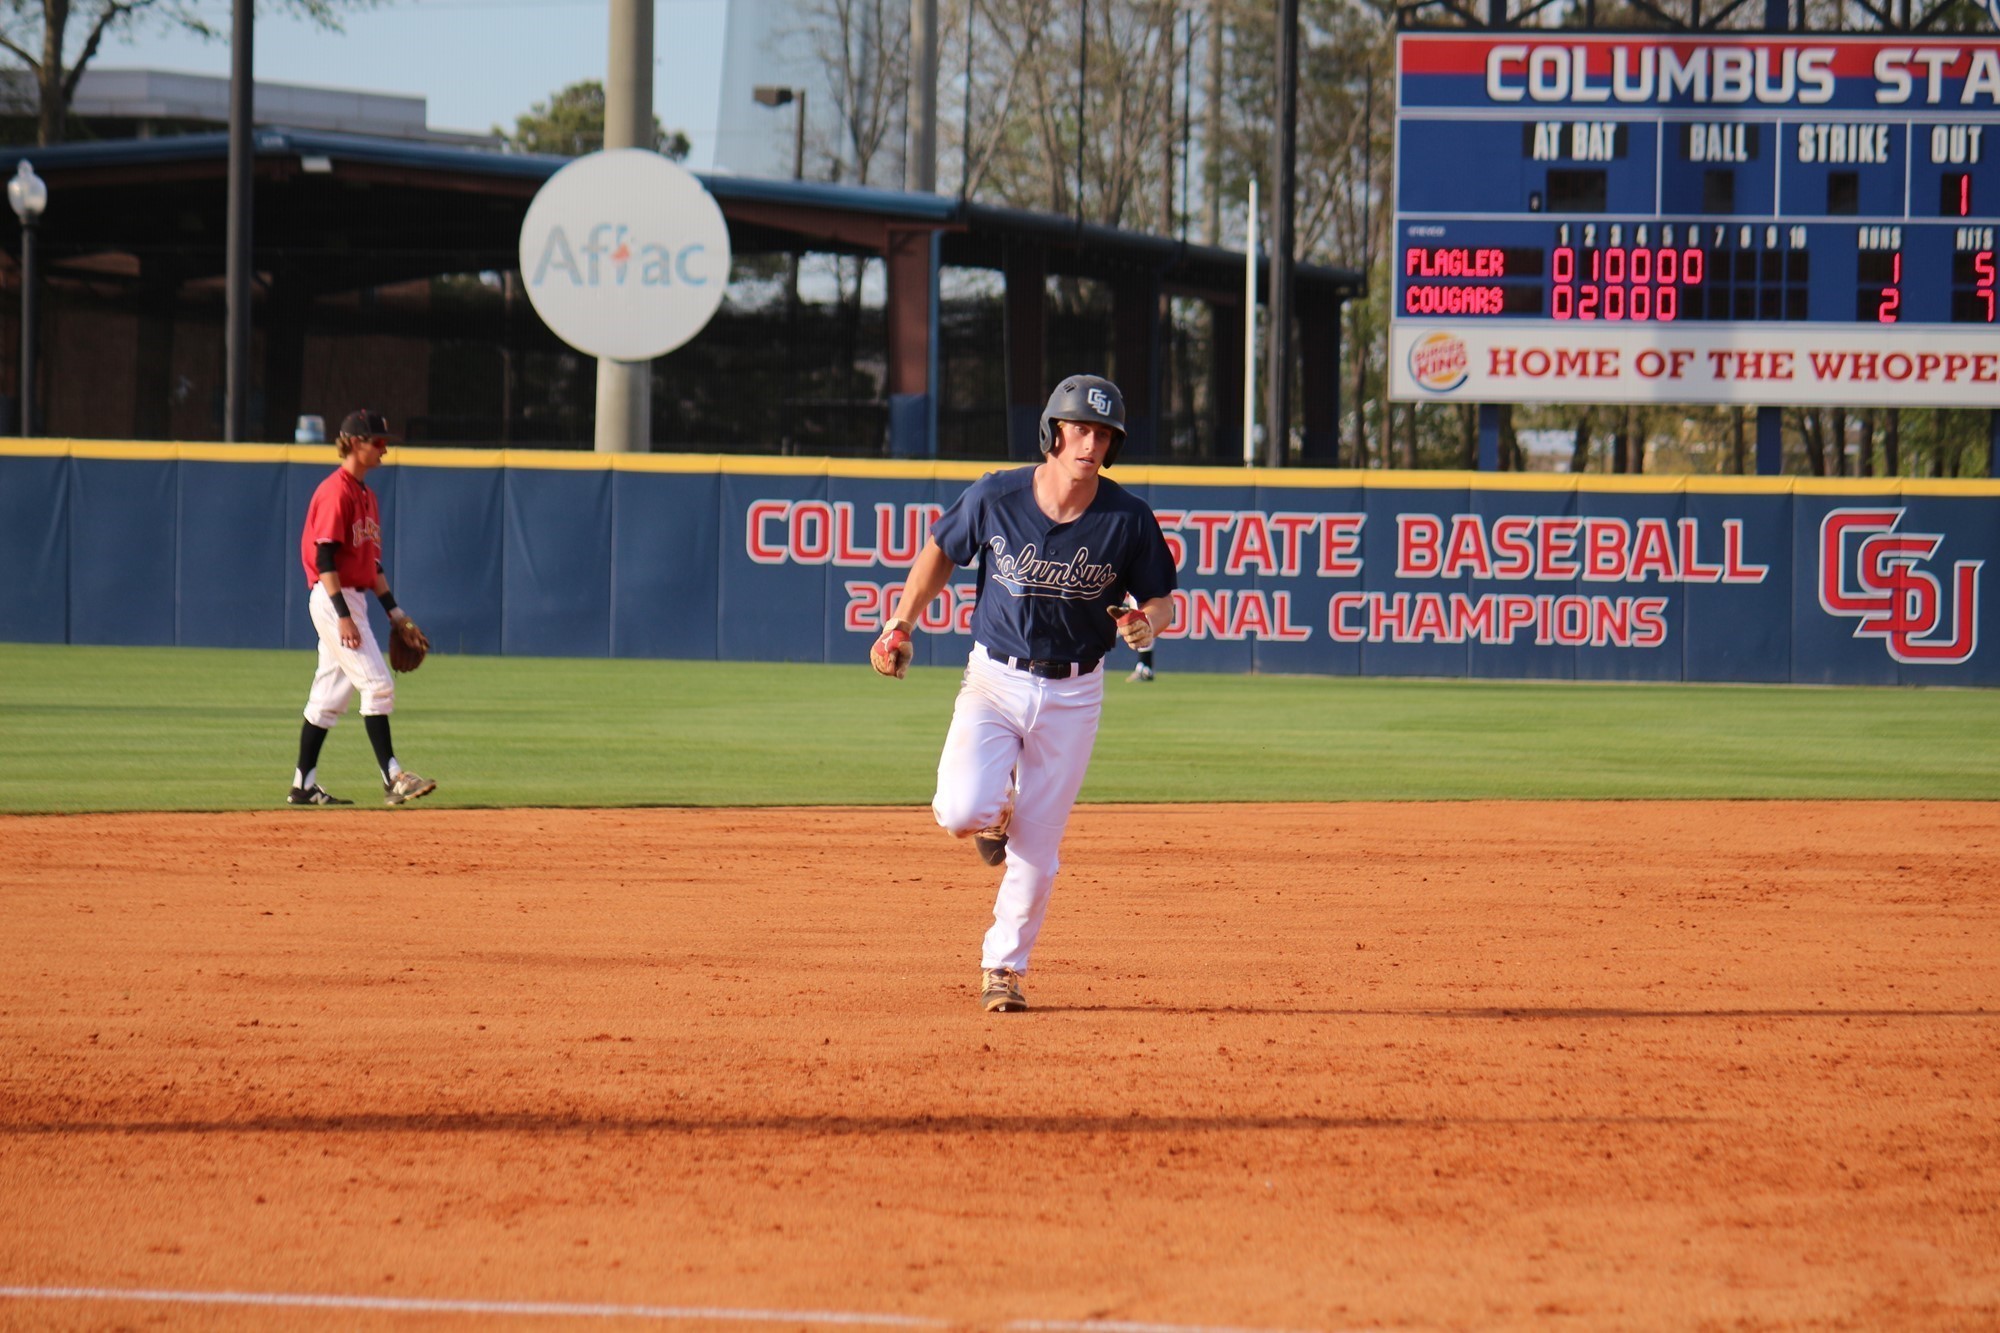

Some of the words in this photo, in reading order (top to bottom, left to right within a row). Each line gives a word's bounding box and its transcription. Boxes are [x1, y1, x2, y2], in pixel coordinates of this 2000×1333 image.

[1486, 45, 1837, 103] COLUMBUS
[1874, 48, 2000, 104] STA
[1533, 121, 1562, 161] AT
[1572, 122, 1617, 161] BAT
[1689, 123, 1748, 162] BALL
[1798, 124, 1889, 163] STRIKE
[1931, 125, 1982, 164] OUT
[1961, 174, 1969, 216] 1
[531, 223, 708, 286] Aflac
[1559, 223, 1570, 247] 1
[1584, 223, 1597, 247] 2
[1610, 224, 1622, 247] 3
[1636, 224, 1648, 247] 4
[1714, 226, 1725, 248] 7
[1789, 226, 1807, 249] 10
[1858, 227, 1901, 249] RUNS
[1956, 227, 1993, 250] HITS
[1406, 248, 1504, 277] FLAGLER
[1893, 252, 1900, 284] 1
[1975, 252, 1995, 286] 5
[1406, 286, 1504, 313] COUGARS
[1879, 288, 1899, 323] 2
[1976, 289, 1994, 322] 7
[1415, 355, 1467, 382] KING
[1488, 347, 1620, 380] HOME
[1635, 348, 1697, 380] OF
[1708, 350, 1795, 381] THE
[746, 499, 947, 568] COLU
[1396, 513, 1769, 584] BASEBALL
[989, 535, 1117, 590] Columbus
[1328, 591, 1669, 648] CHAMPIONS
